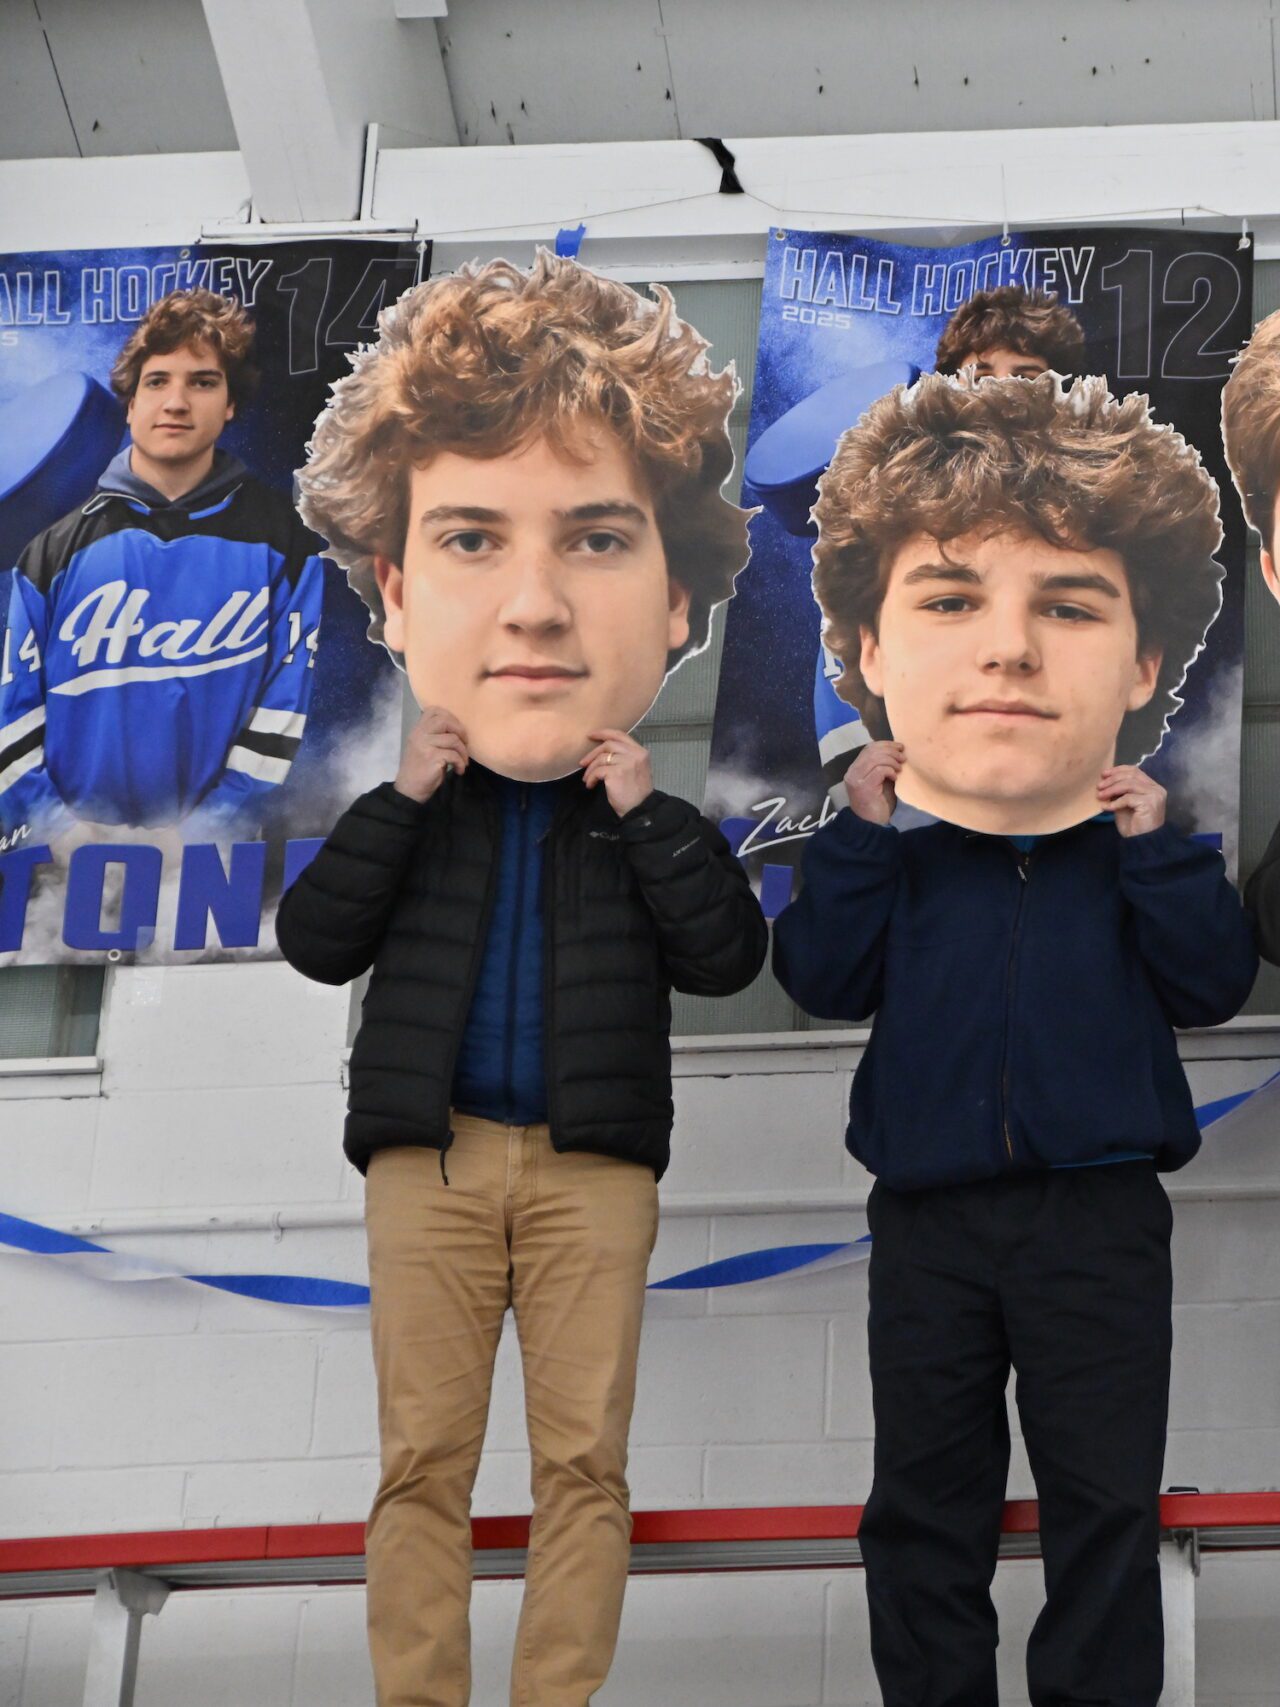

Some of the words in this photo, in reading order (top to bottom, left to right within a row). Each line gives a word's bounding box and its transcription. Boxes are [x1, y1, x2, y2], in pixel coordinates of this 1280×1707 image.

[81, 256, 274, 324] HOCKEY
[276, 257, 419, 375] 14
[779, 246, 902, 315] HALL
[911, 246, 1096, 317] HOCKEY
[782, 304, 853, 330] 2025
[1101, 249, 1242, 380] 12
[58, 579, 270, 668] Hall
[0, 837, 328, 952] TON
